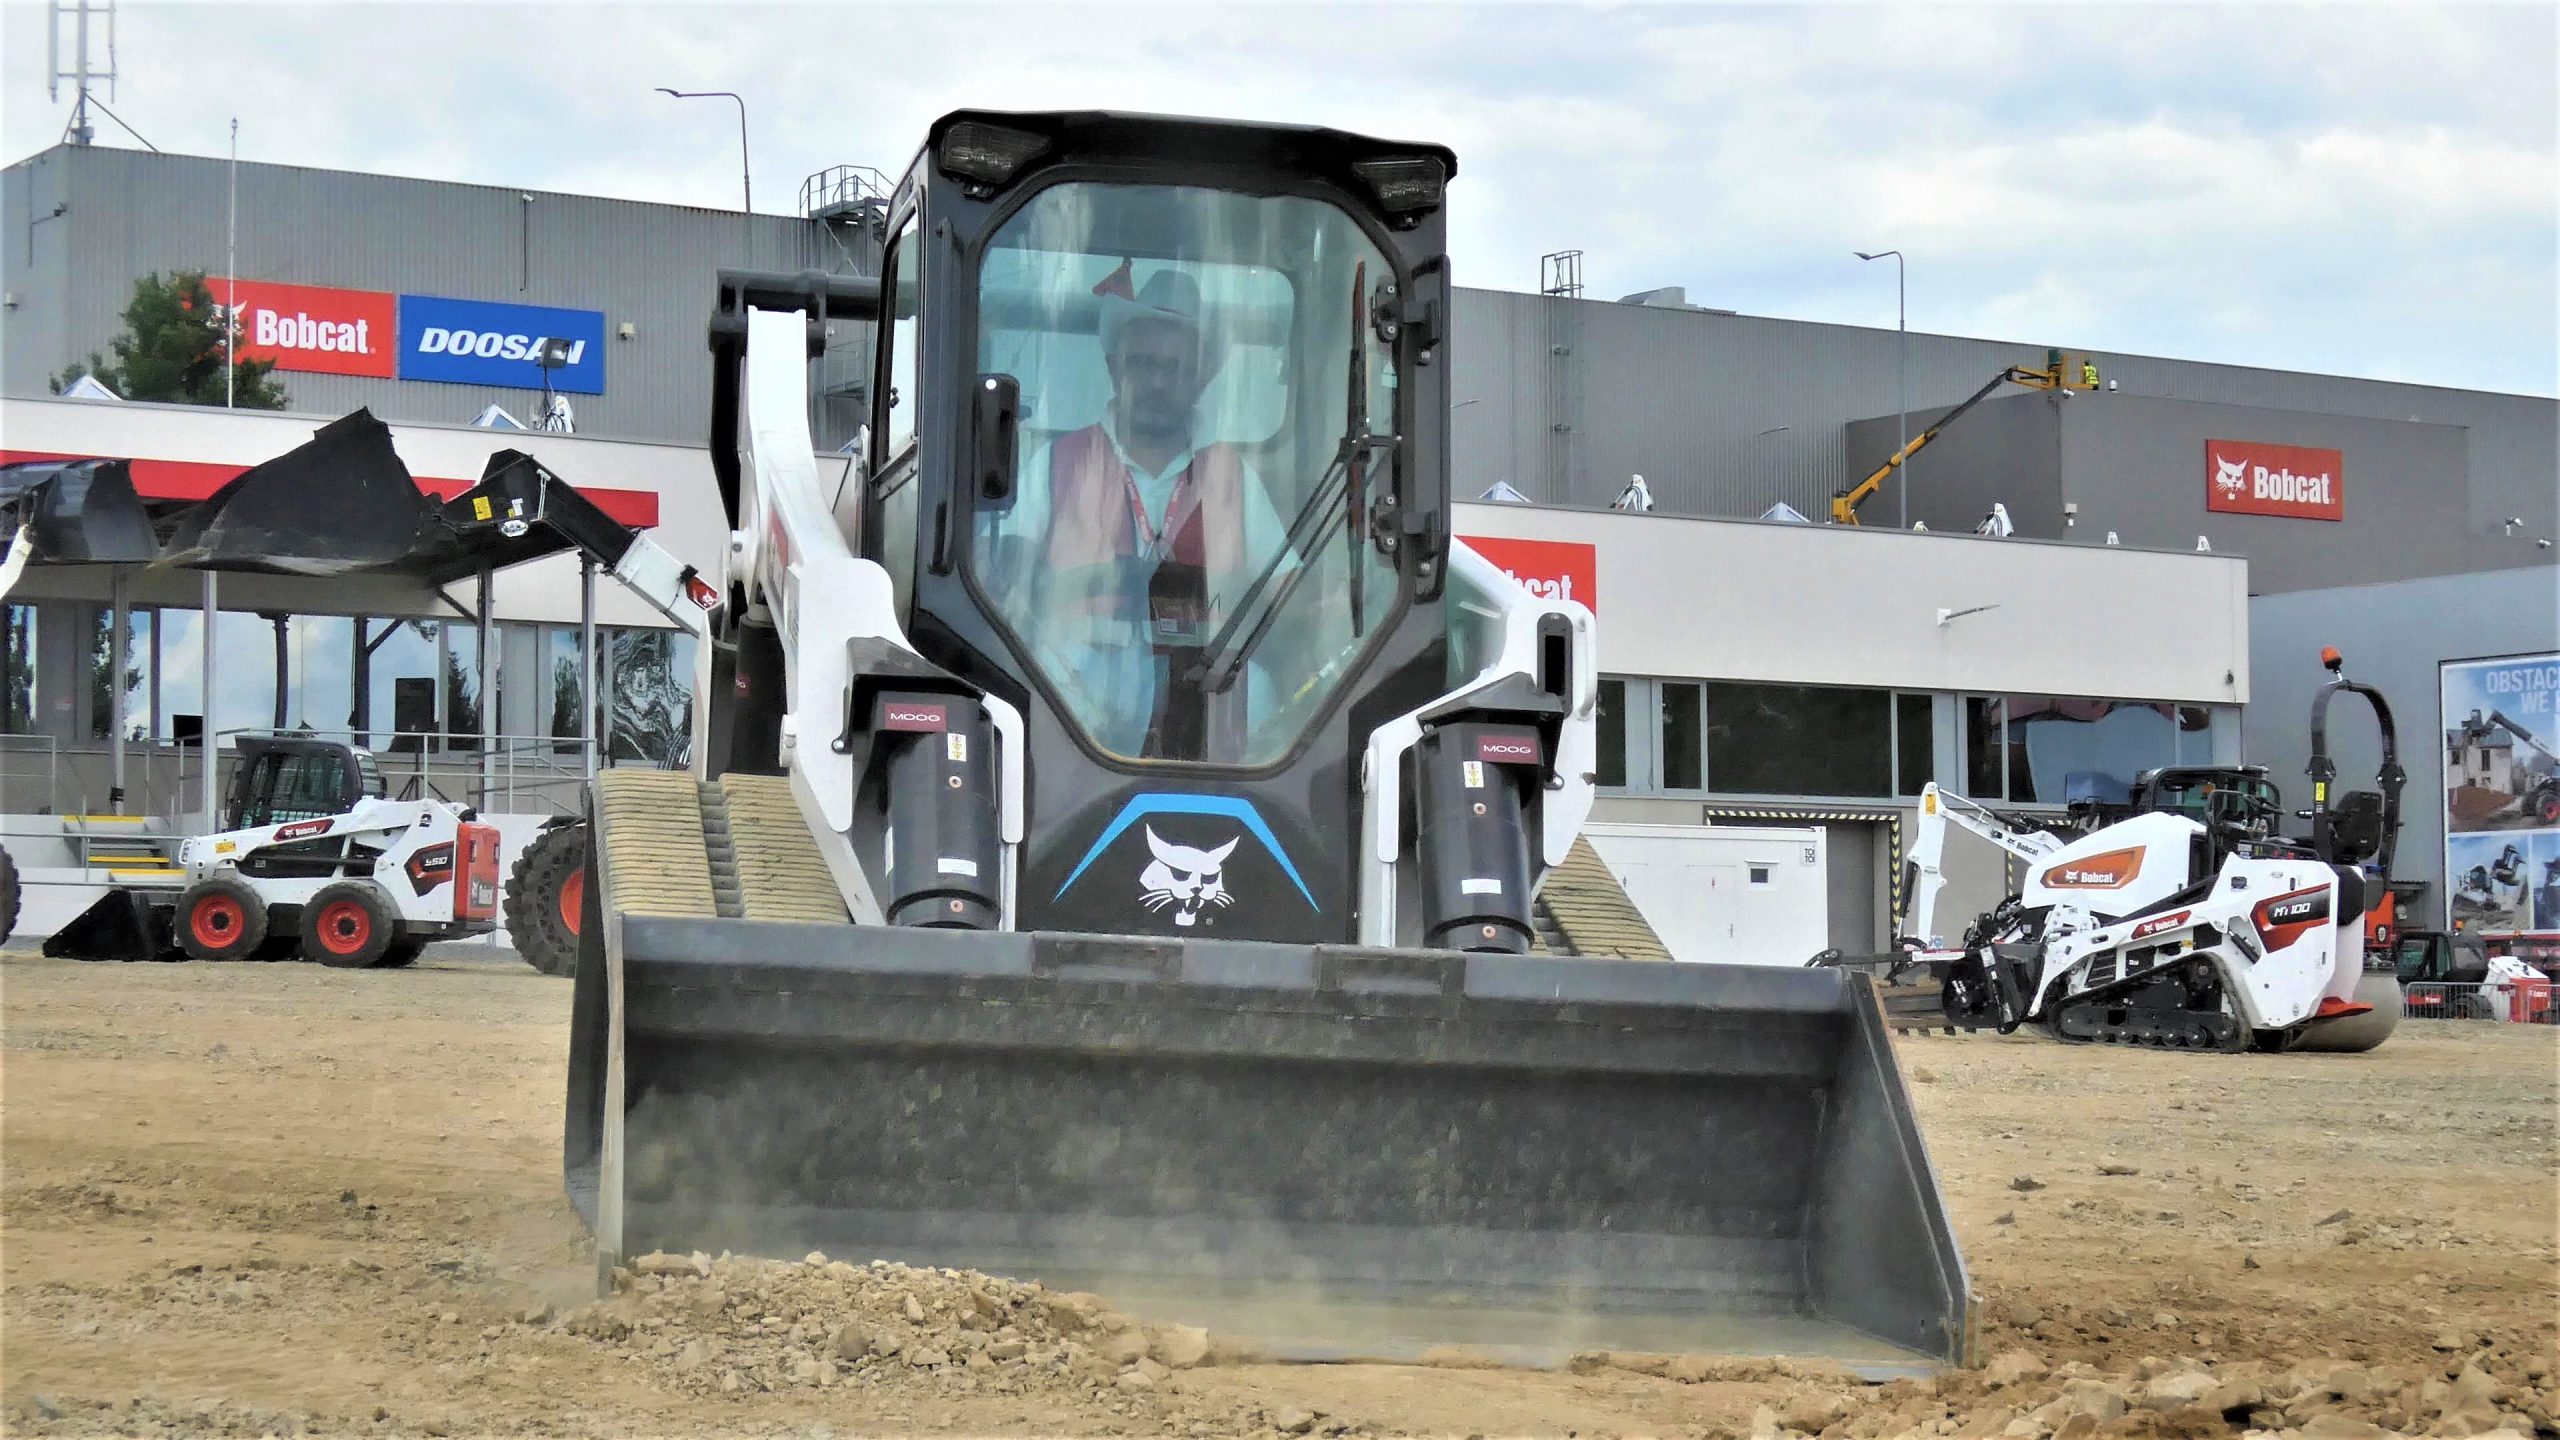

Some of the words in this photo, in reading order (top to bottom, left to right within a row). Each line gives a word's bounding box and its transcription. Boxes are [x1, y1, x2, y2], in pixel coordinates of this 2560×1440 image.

[256, 309, 369, 354] Bobcat
[2253, 465, 2331, 505] Bobcat
[2521, 691, 2550, 714] WE
[890, 712, 941, 722] MOOG
[1483, 744, 1532, 754] MOOG
[418, 813, 432, 828] 2
[2081, 872, 2114, 884] Bobcat
